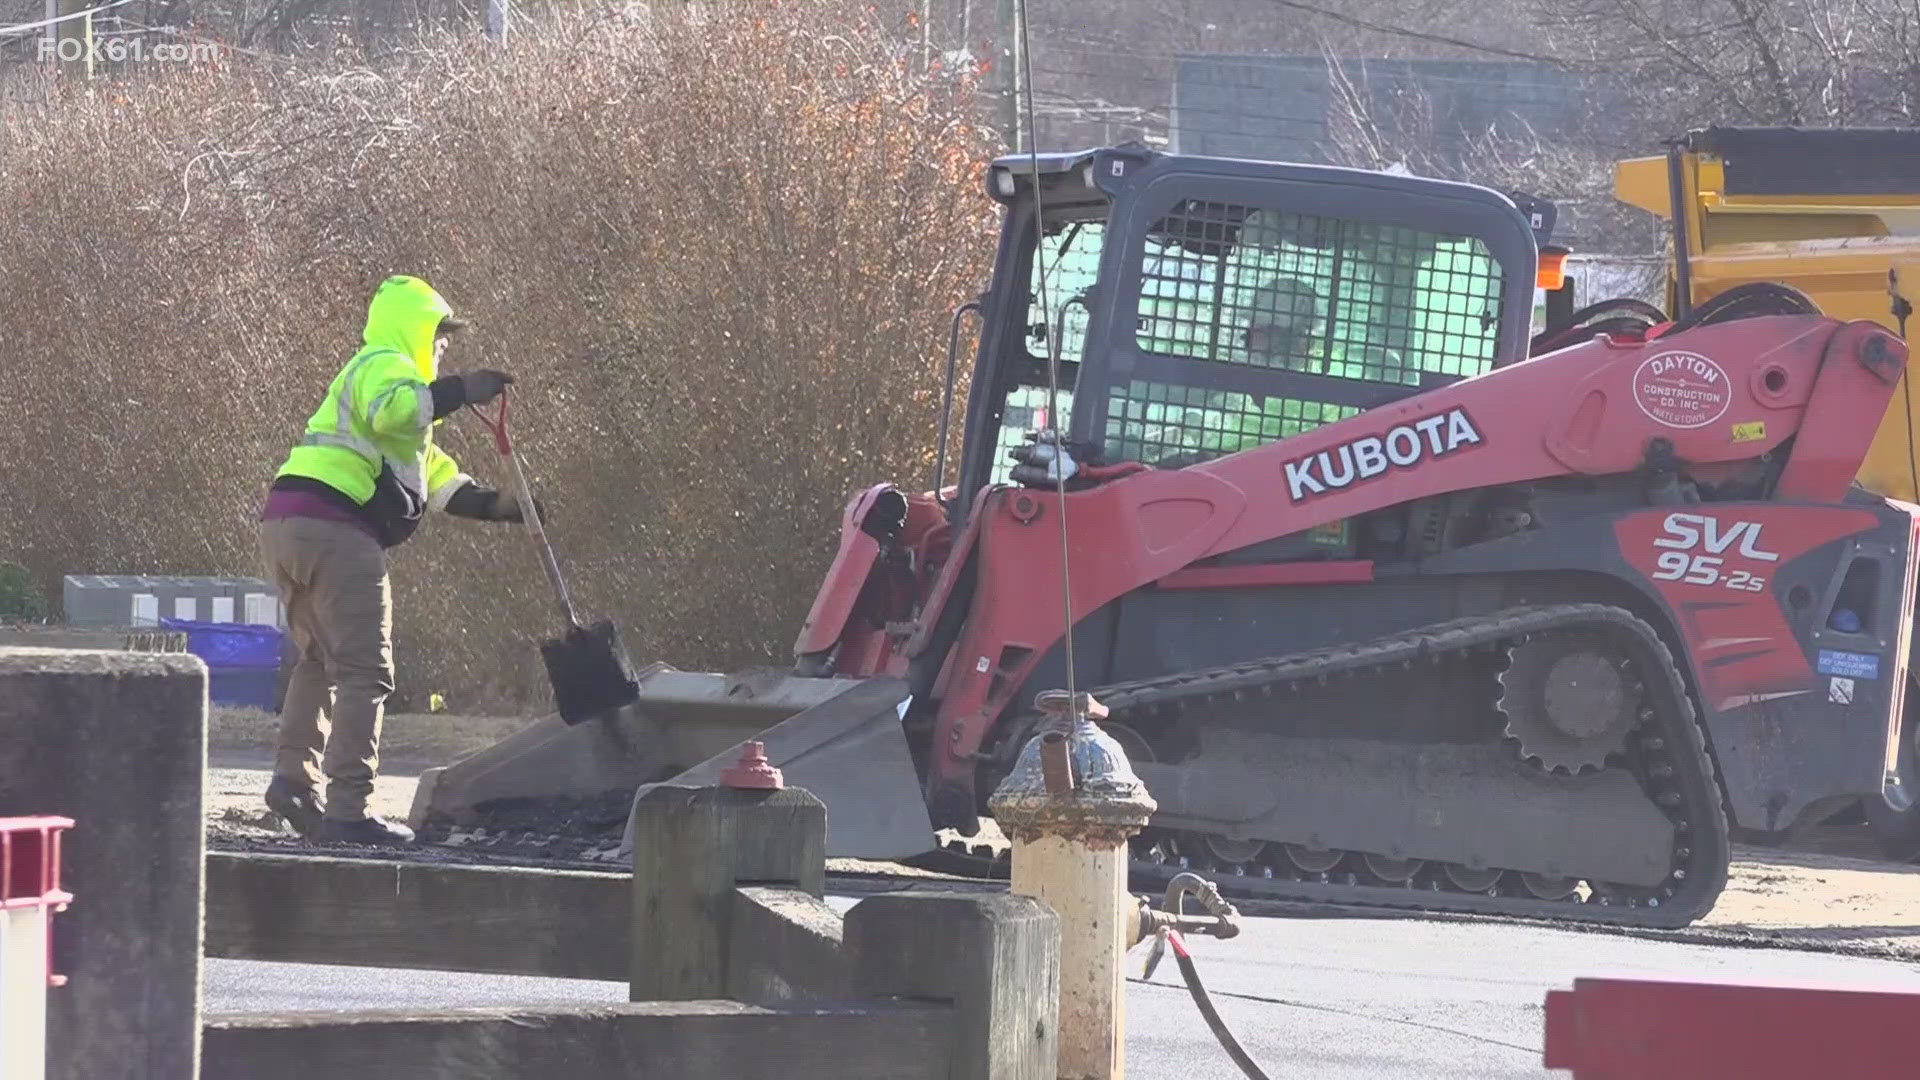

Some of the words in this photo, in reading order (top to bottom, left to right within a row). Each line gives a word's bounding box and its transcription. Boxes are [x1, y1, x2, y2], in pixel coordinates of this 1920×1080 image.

[1651, 355, 1719, 383] DAYTON
[1643, 384, 1720, 403] CONSTRUCTION
[1660, 397, 1677, 408] CO.
[1680, 400, 1699, 410] INC
[1653, 407, 1706, 424] WATERTOWN
[1284, 409, 1480, 500] KUBOTA
[1653, 512, 1779, 561] SVL
